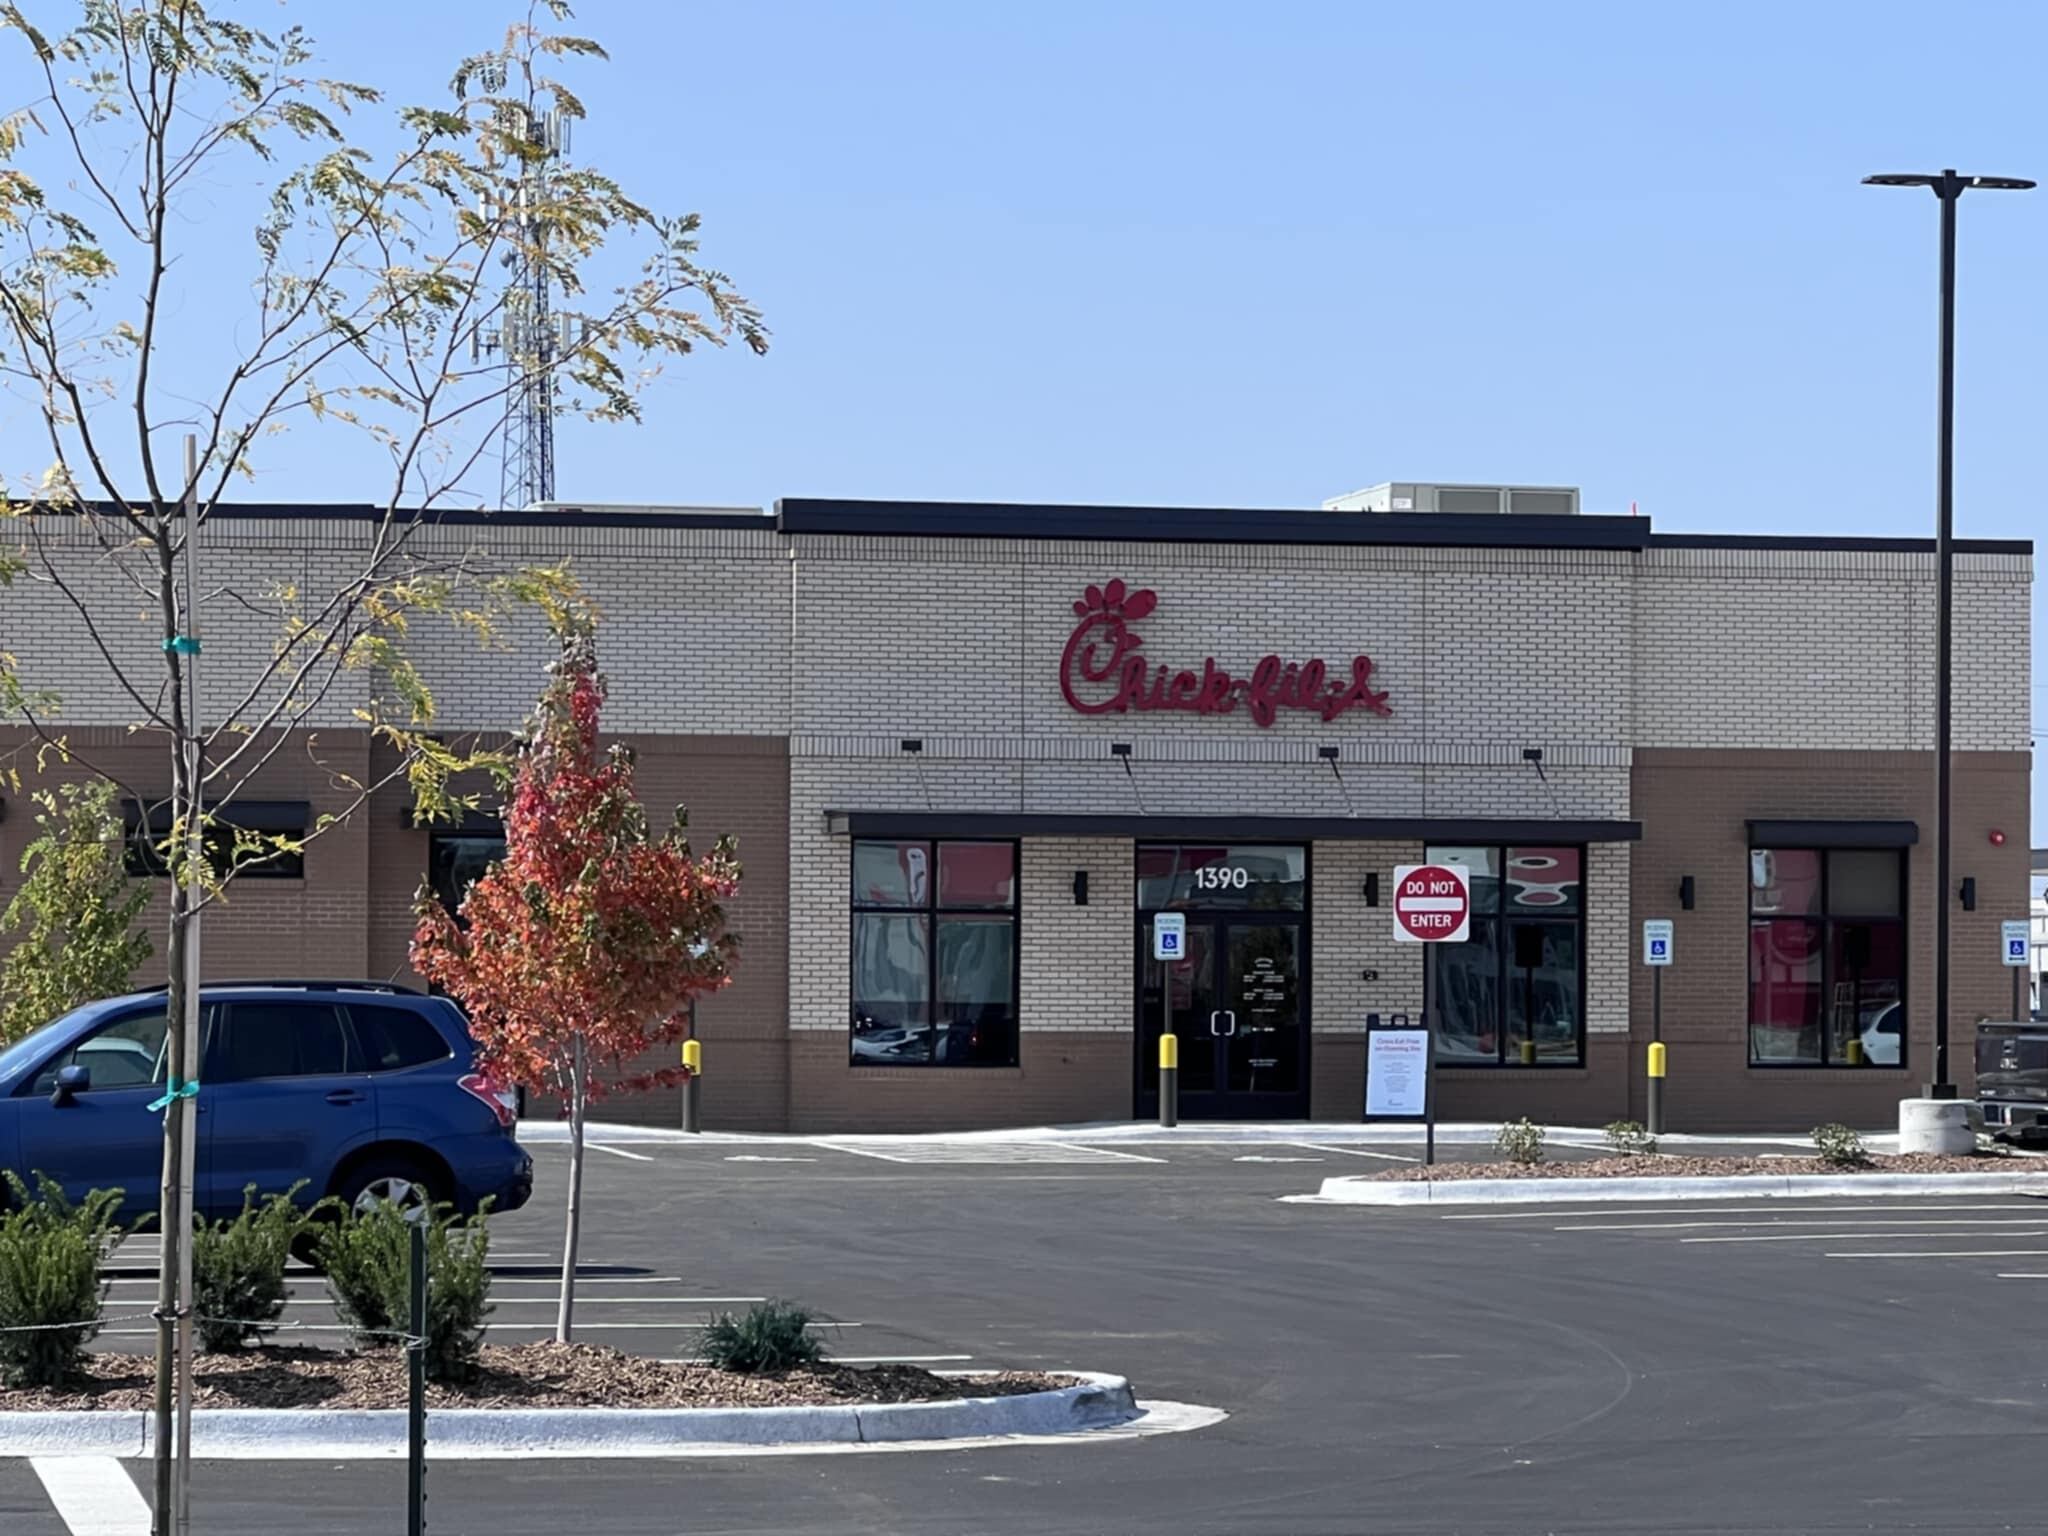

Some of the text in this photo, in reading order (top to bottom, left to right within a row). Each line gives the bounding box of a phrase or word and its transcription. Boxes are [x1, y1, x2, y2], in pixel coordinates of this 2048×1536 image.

[1060, 606, 1393, 727] Chick-fil-A
[1195, 867, 1248, 889] 1390
[1407, 881, 1456, 895] DO NOT
[1411, 914, 1452, 927] ENTER
